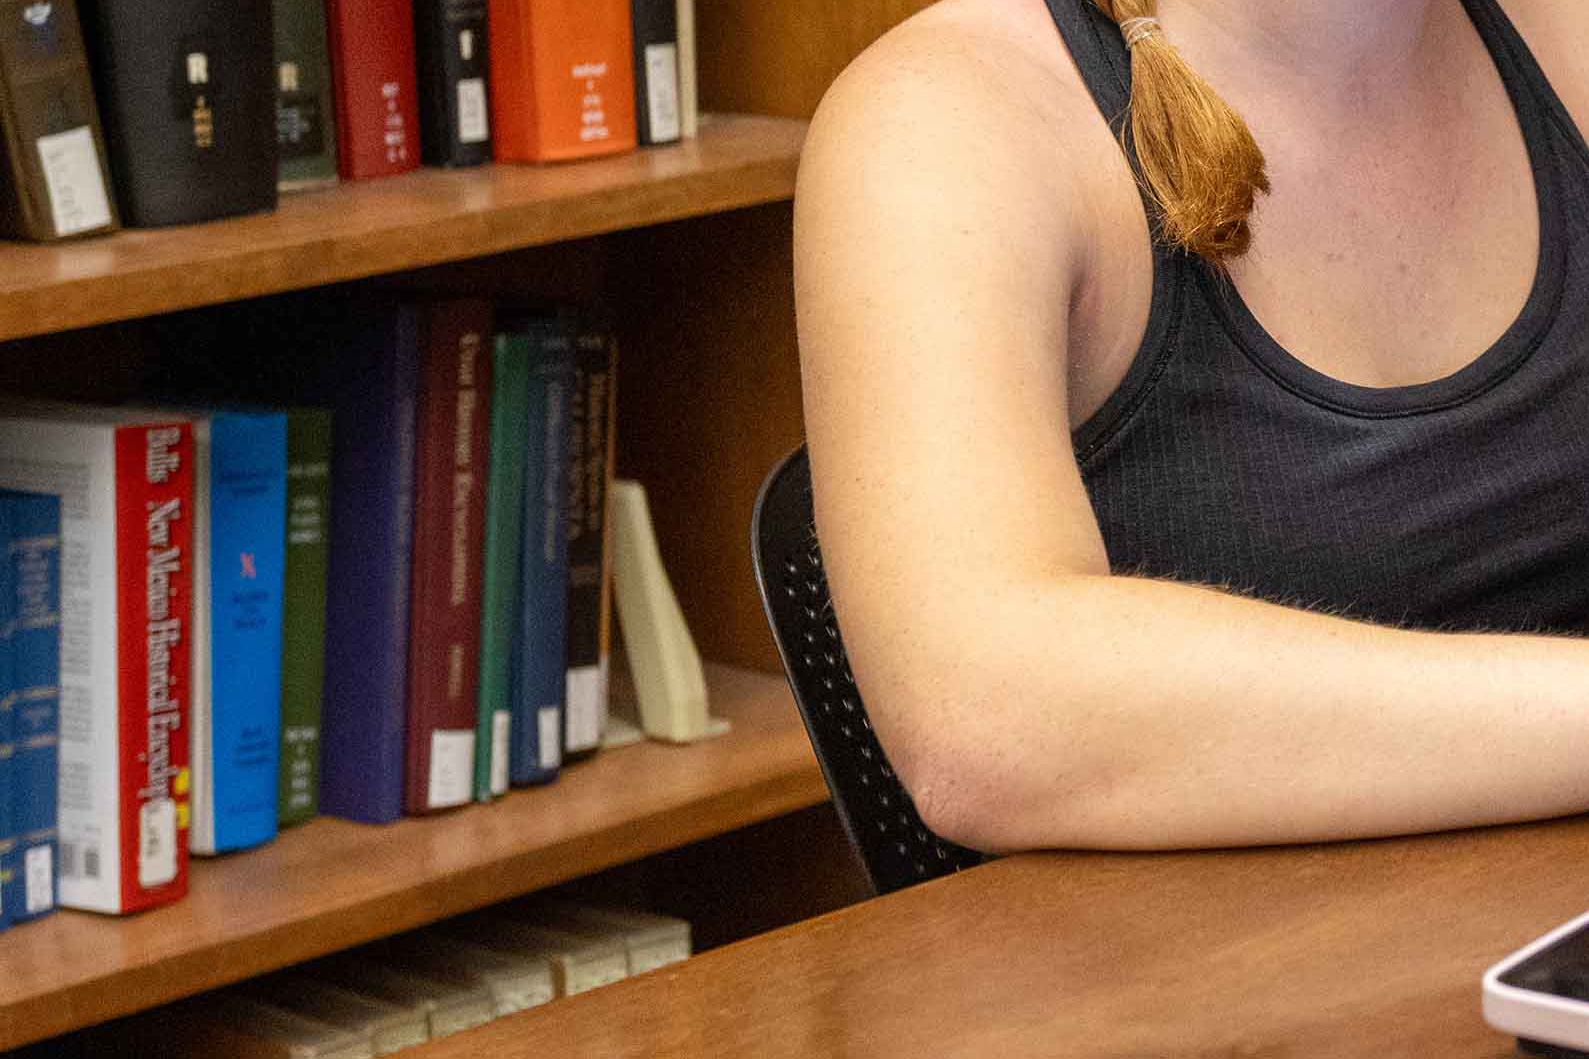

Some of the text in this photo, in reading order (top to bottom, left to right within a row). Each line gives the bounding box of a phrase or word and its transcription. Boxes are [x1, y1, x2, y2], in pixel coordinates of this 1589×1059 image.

[146, 427, 181, 483] Bullis
[137, 497, 181, 804] New Mexico Historical Encyclop
